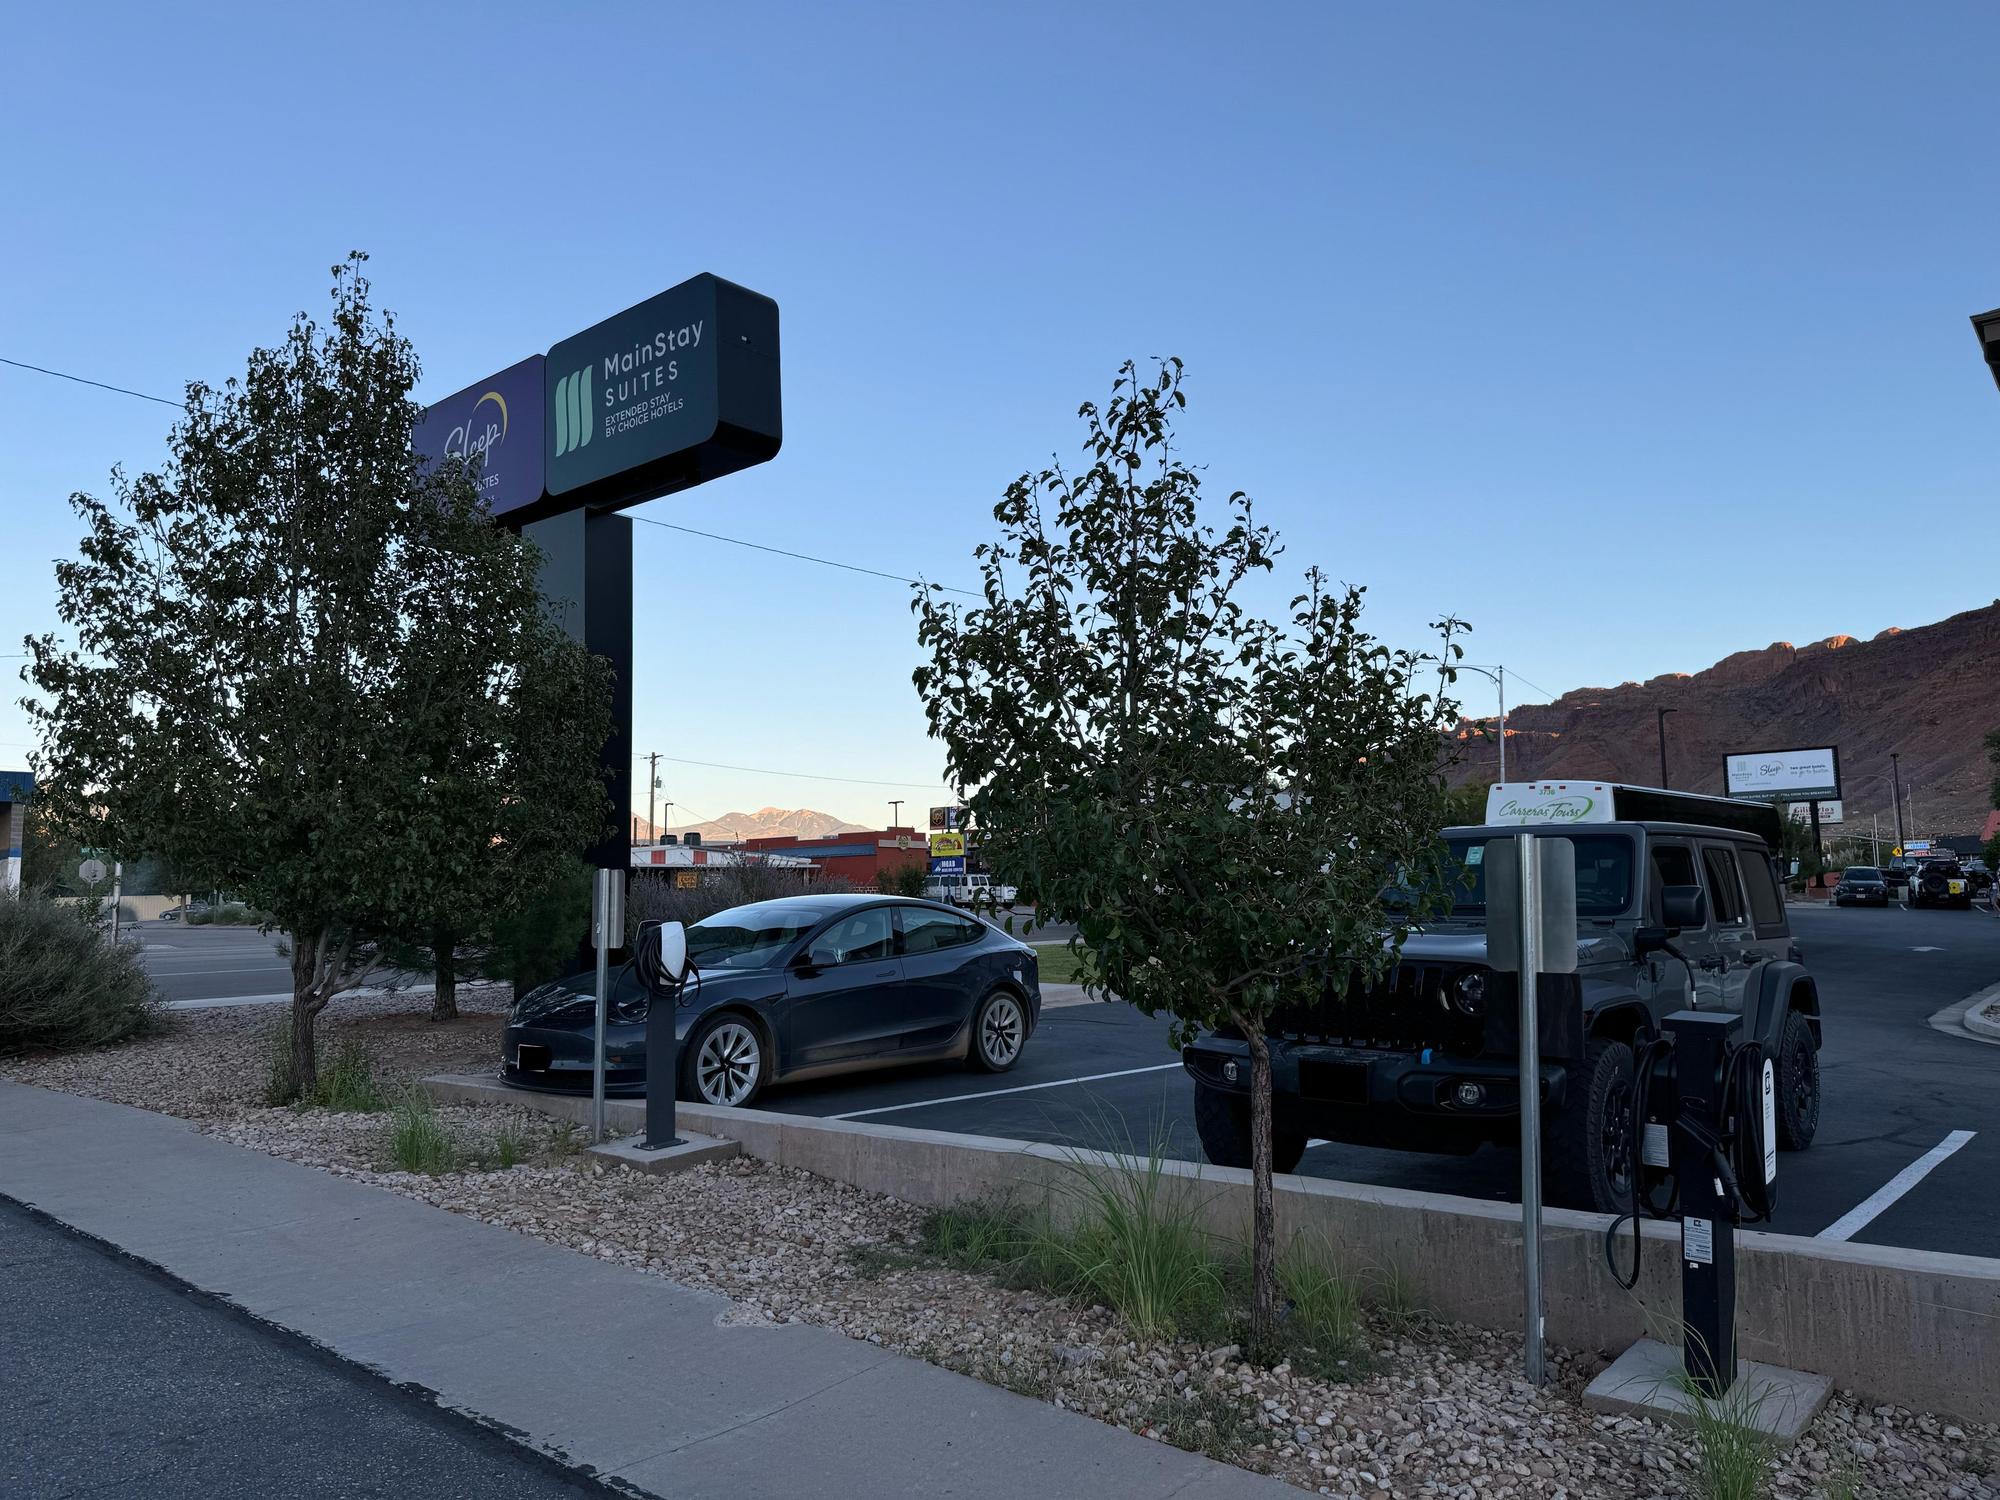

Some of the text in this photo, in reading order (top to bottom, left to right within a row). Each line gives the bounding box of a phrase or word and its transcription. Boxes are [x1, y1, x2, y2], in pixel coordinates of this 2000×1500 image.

[604, 319, 703, 381] MainStay
[605, 360, 678, 407] SUITES
[605, 391, 671, 427] EXTENDED STAY
[606, 398, 684, 438] BY CHOICE HOTELS
[444, 418, 501, 467] Sleep
[1499, 799, 1582, 820] Carreras Tours
[941, 860, 956, 868] MOAB
